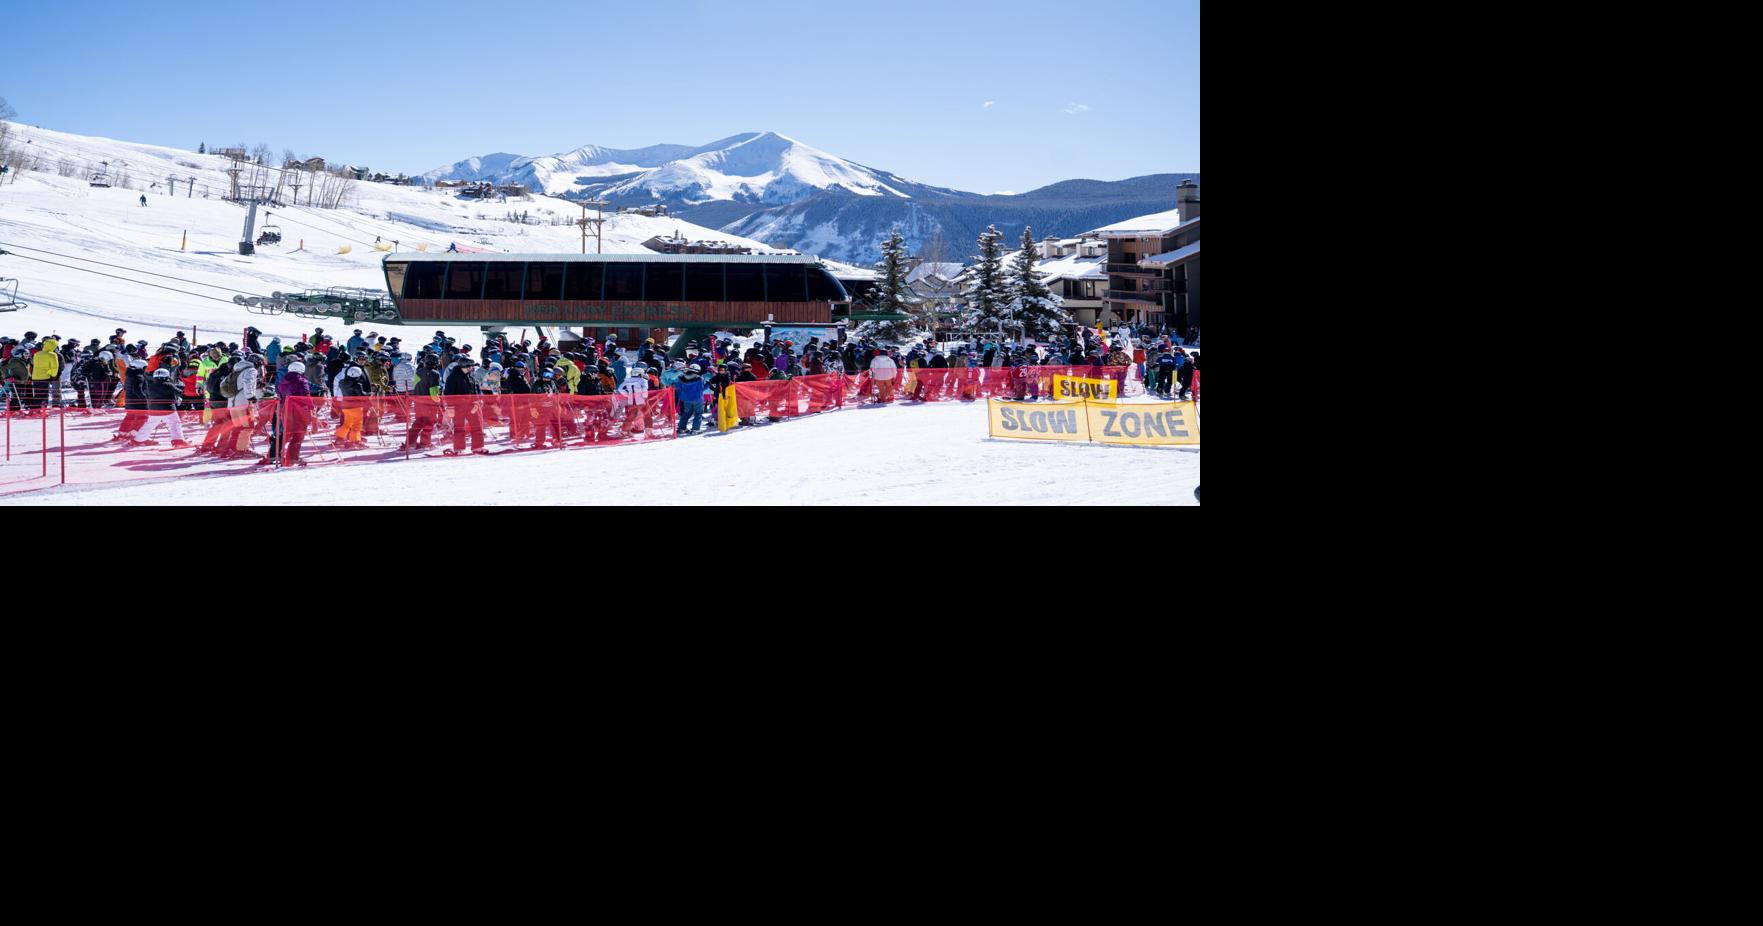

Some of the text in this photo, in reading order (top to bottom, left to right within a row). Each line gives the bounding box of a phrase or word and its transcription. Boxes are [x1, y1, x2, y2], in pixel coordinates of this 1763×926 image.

[1060, 379, 1110, 400] SLOW
[1000, 407, 1189, 438] SLOW ZONE
